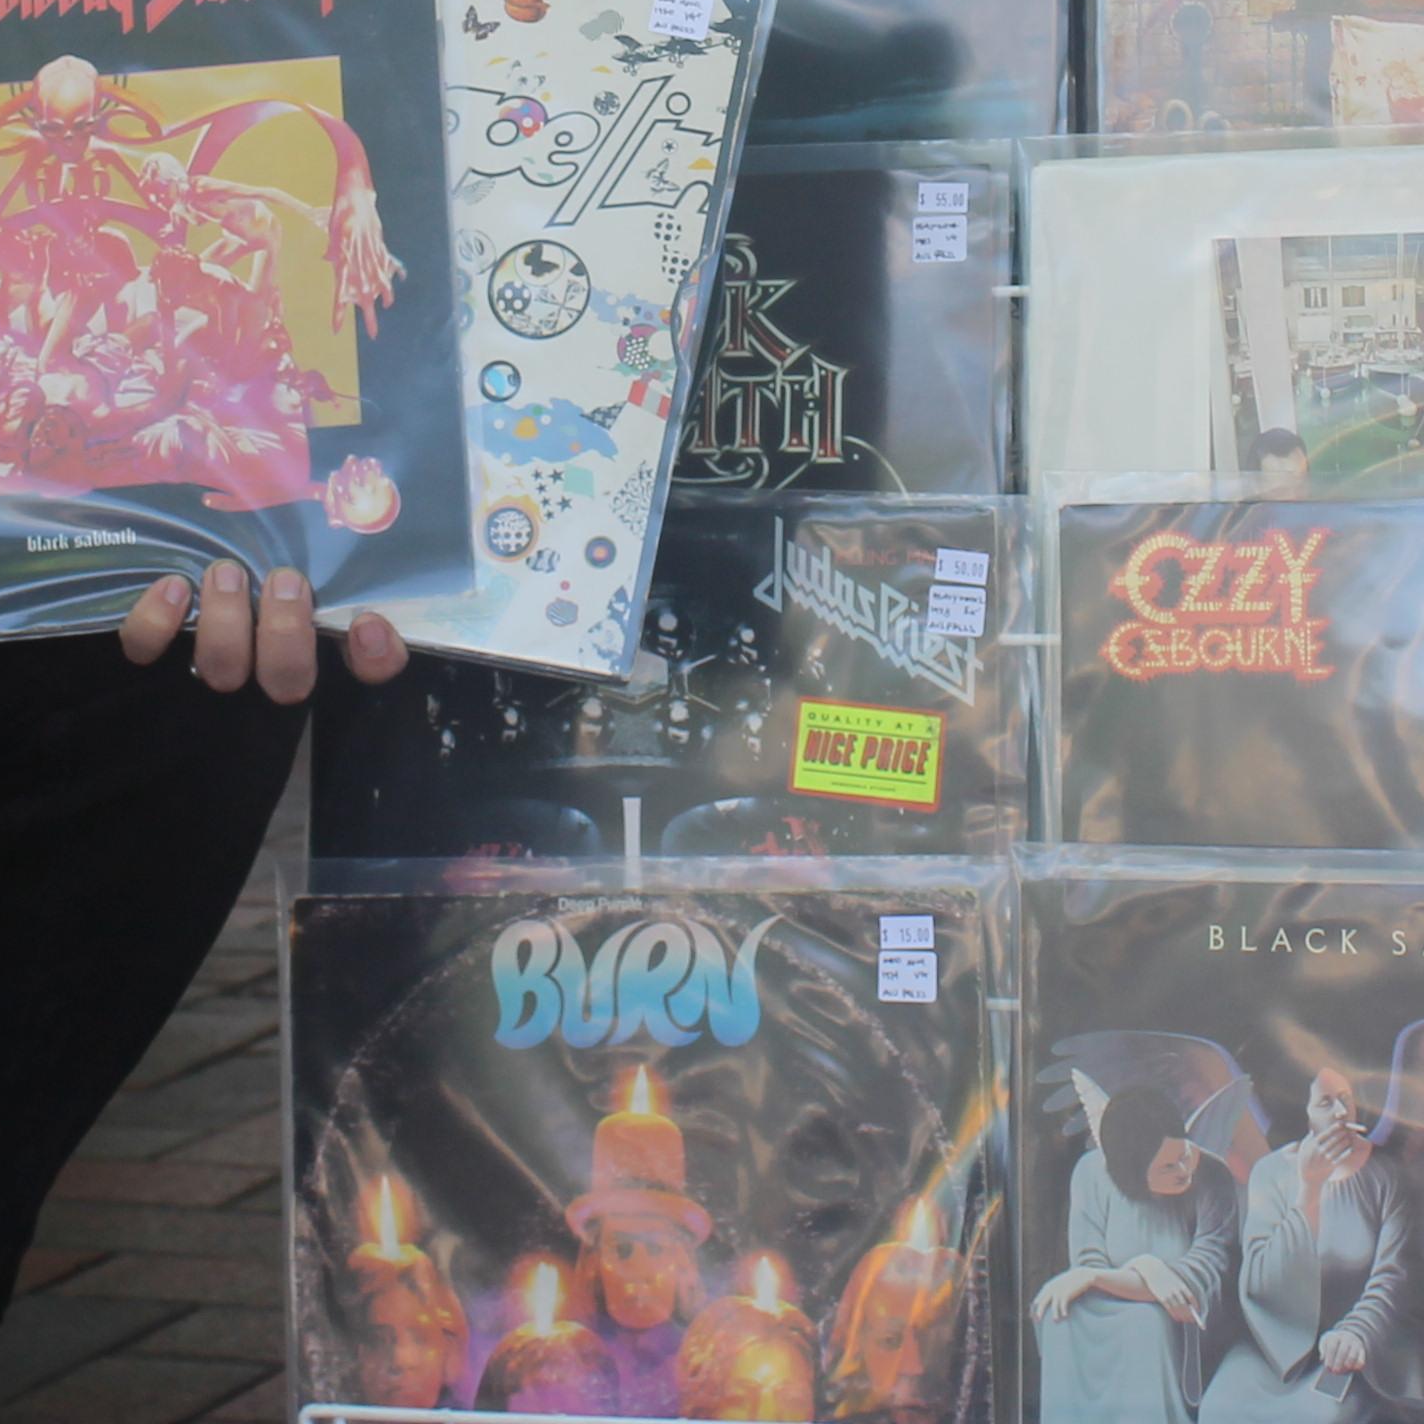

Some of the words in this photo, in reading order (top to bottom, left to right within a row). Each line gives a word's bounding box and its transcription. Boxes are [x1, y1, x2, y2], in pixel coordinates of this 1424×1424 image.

[920, 193, 925, 206] $
[27, 533, 69, 552] black
[74, 527, 136, 548] sabbath
[938, 559, 944, 572] $
[954, 560, 985, 578] 50.00
[1106, 528, 1334, 627] OZZY
[753, 514, 876, 638] Judas
[879, 581, 984, 707] Priest
[1100, 620, 1334, 679] OSBOURNE
[808, 711, 883, 727] QUALITY
[895, 722, 914, 731] AT
[803, 729, 858, 767] NICE
[860, 735, 932, 775] PRICE
[882, 928, 888, 942] $
[899, 927, 930, 943] 15.00
[1208, 925, 1359, 956] BLACK
[491, 914, 784, 1050] BURN
